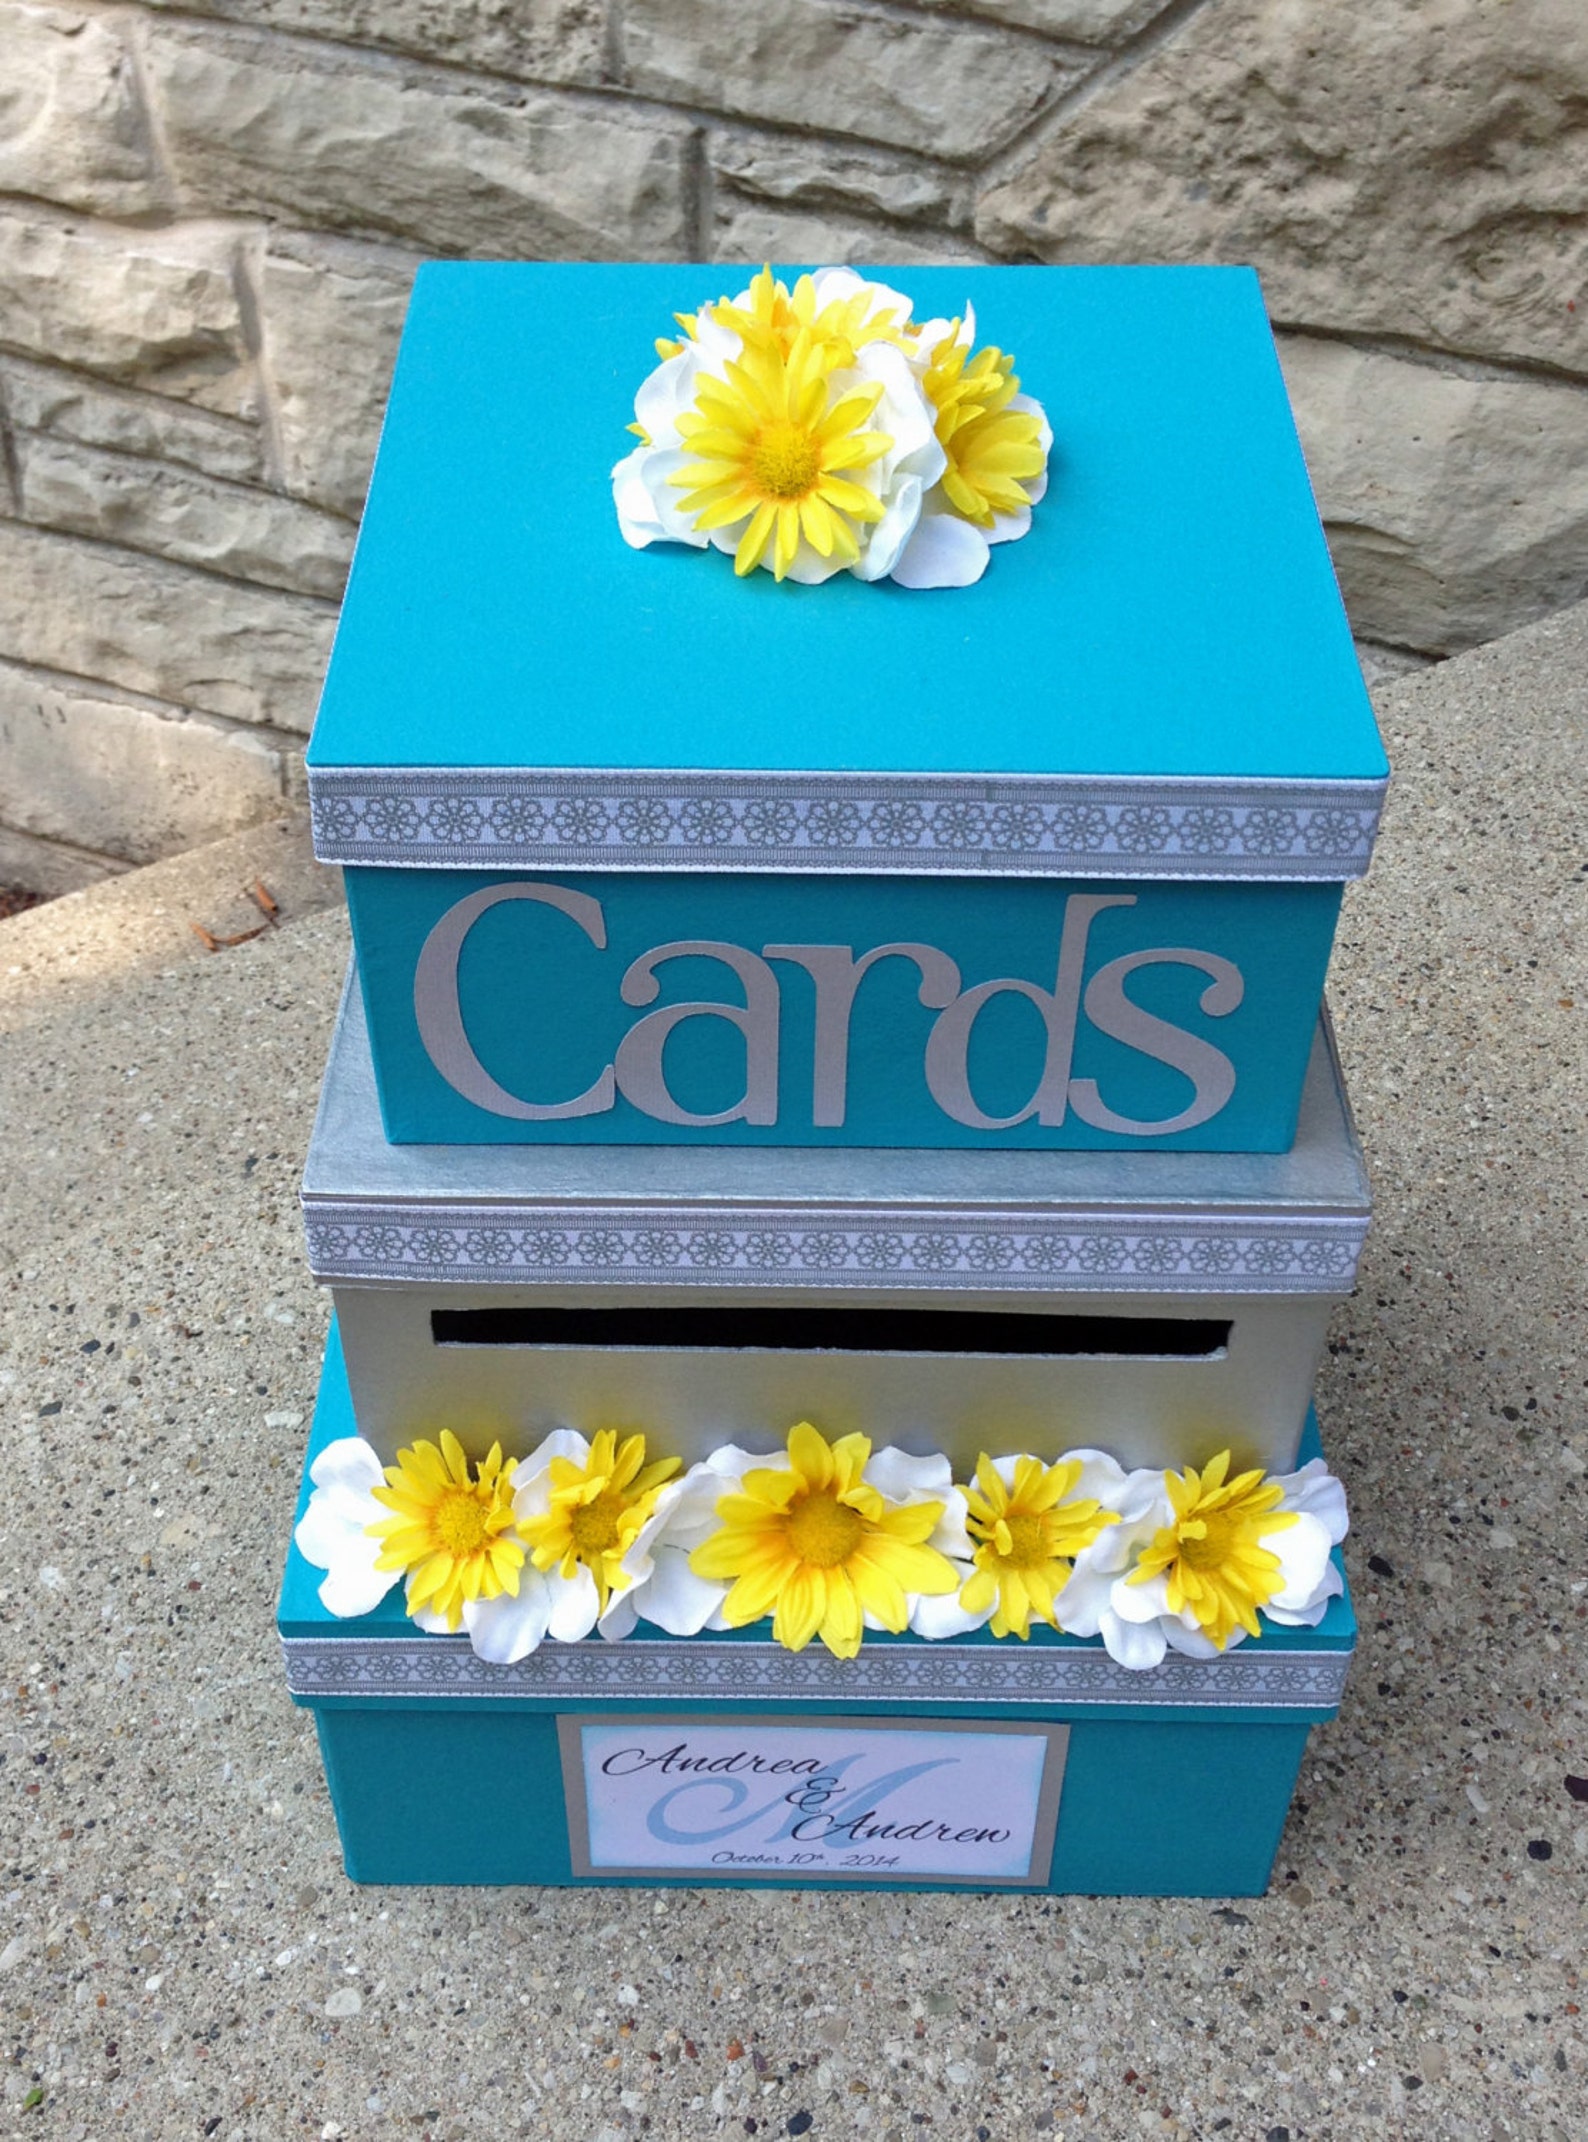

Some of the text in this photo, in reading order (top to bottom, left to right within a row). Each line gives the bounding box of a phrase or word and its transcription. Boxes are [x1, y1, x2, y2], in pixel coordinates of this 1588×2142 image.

[413, 881, 1245, 1136] Cards
[601, 1743, 827, 1777] Andrea
[785, 1777, 846, 1814] &
[791, 1811, 1011, 1843] Andrew
[711, 1850, 784, 1865] October
[839, 1854, 901, 1868] 2014
